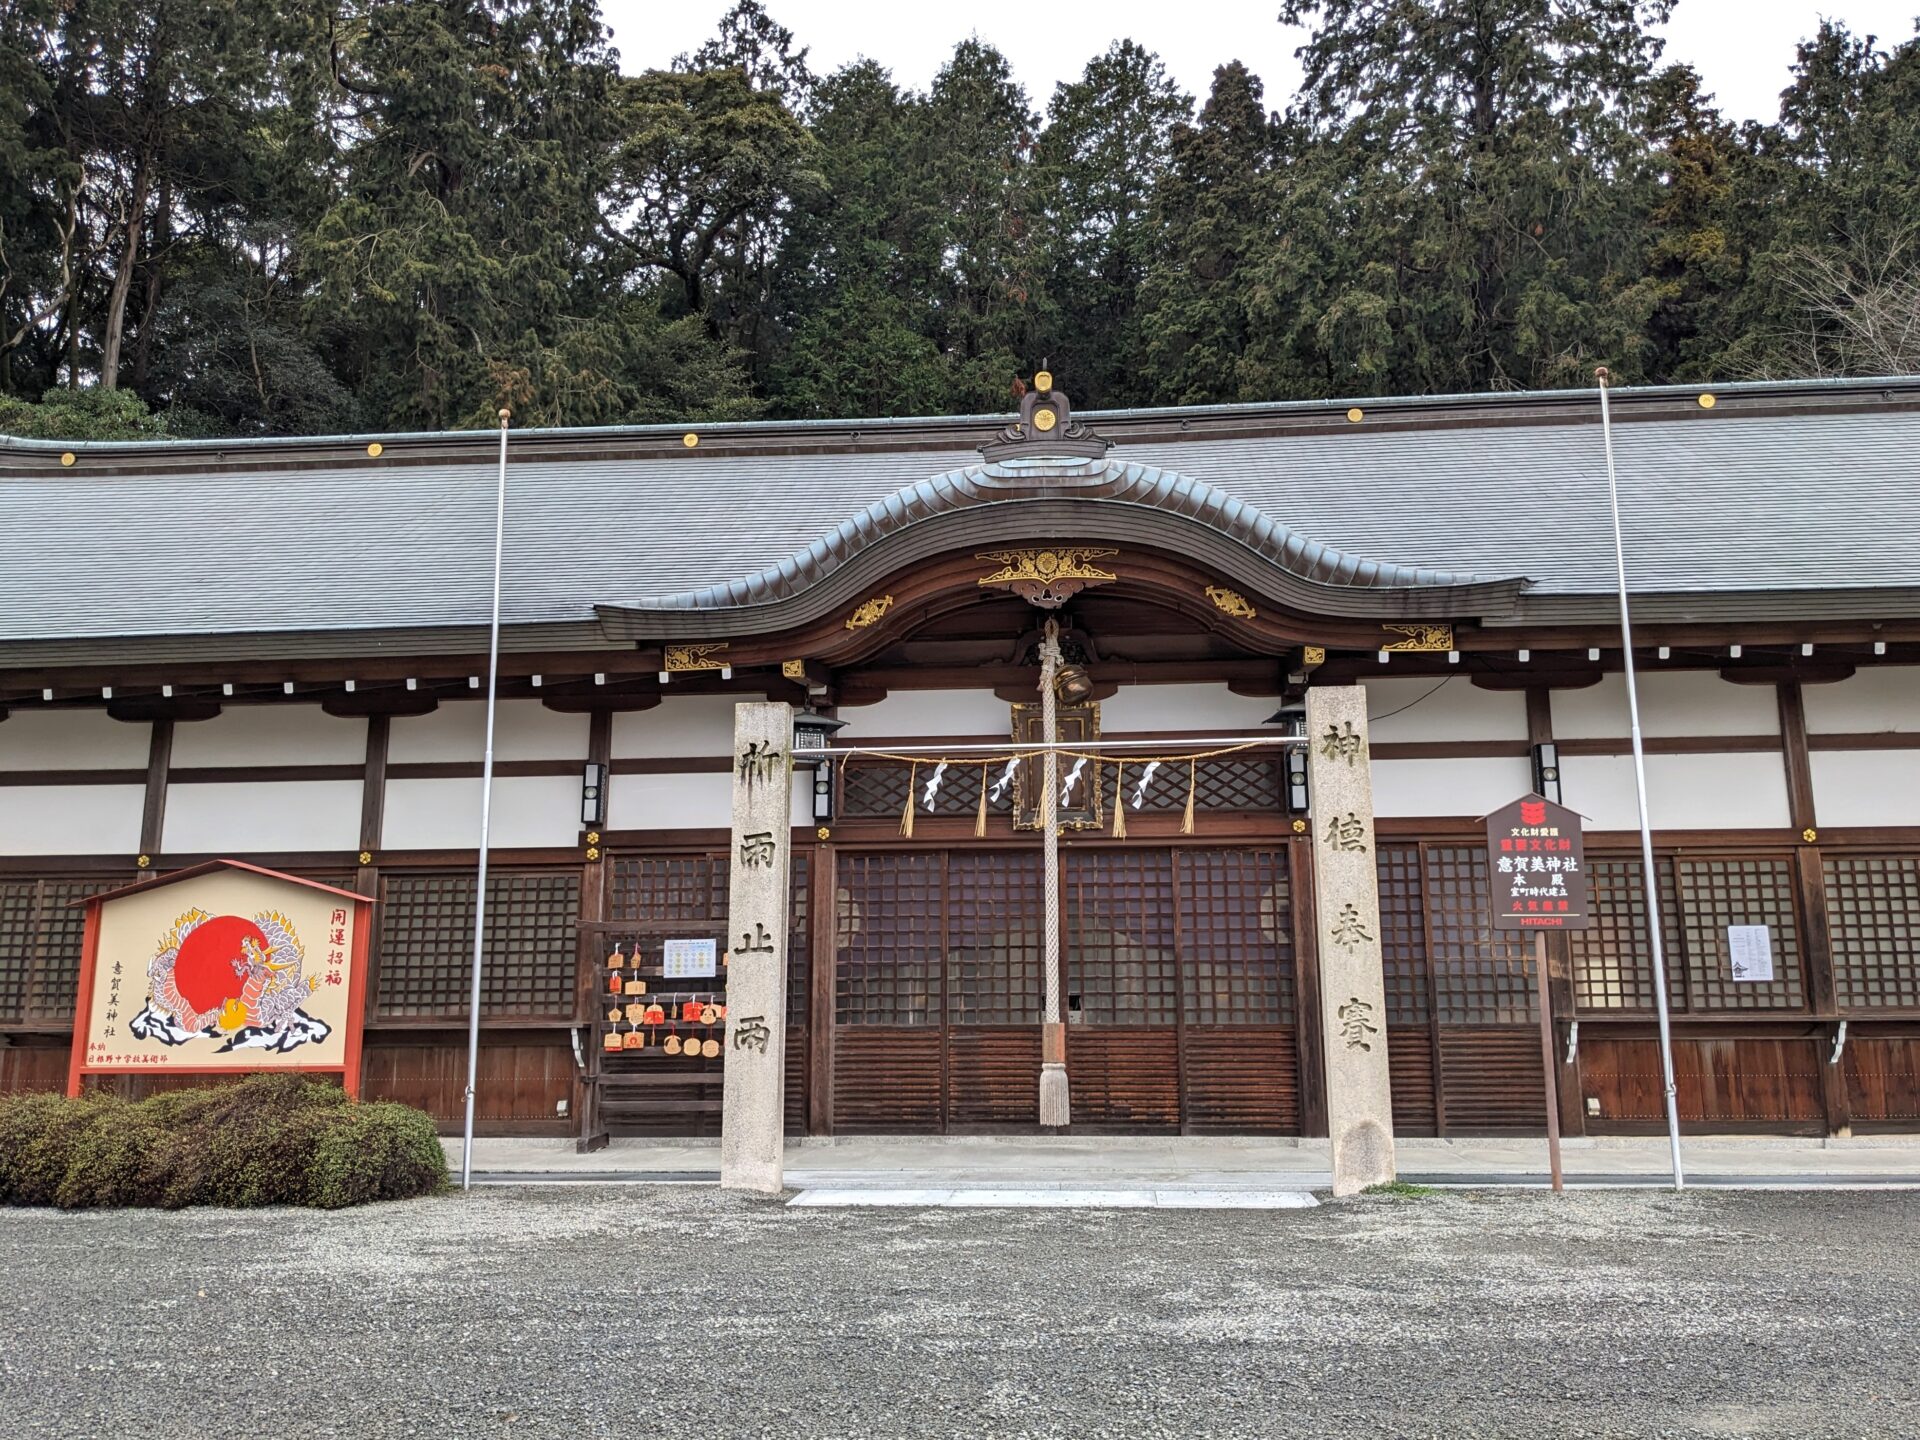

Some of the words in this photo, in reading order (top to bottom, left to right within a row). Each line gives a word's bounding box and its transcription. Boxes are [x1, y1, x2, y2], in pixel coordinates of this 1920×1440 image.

[1496, 856, 1579, 873] 意賀美神社
[1510, 887, 1568, 897] 室町時代建立
[1521, 918, 1563, 926] HITACHI
[325, 908, 346, 986] 開運招福
[103, 960, 124, 1038] 意賀美神社
